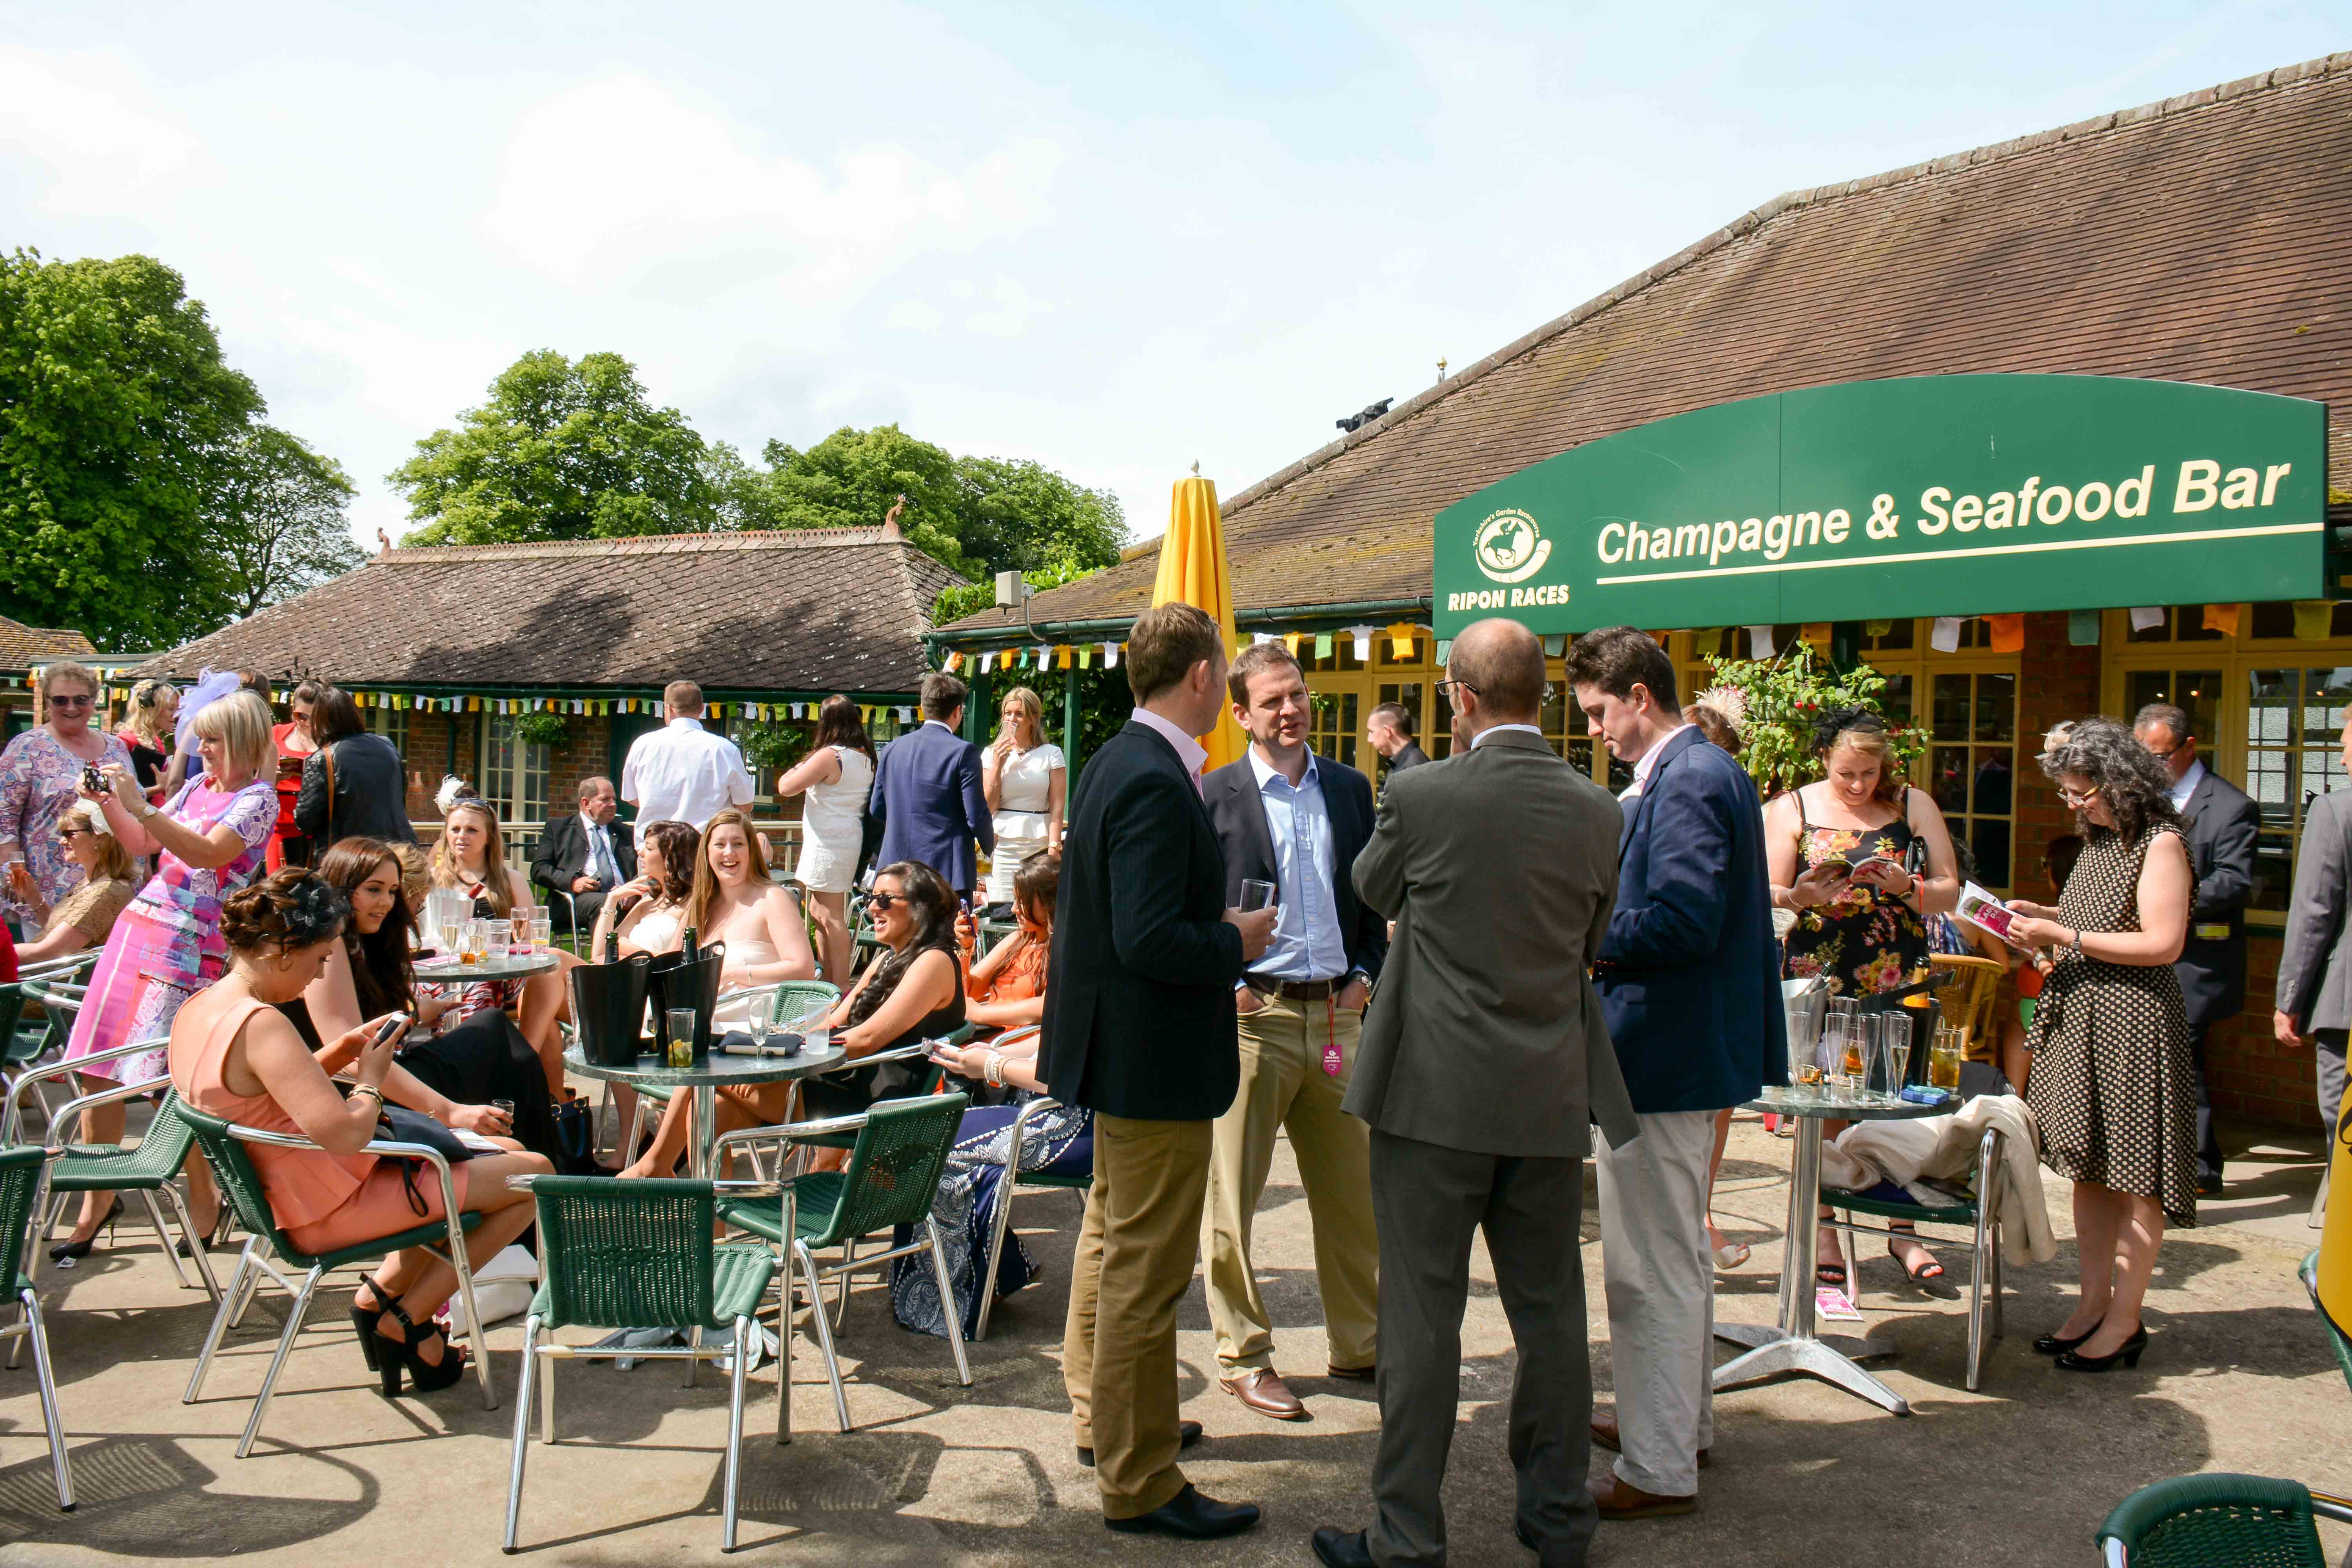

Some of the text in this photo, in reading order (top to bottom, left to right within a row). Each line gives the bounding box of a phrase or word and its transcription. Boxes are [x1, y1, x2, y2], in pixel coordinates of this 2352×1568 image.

[1473, 508, 1540, 546] Yorkshire's Garden Racecourse
[1597, 459, 2292, 565] Champagne & Seafood Bar
[1448, 584, 1570, 611] RIPON RACES
